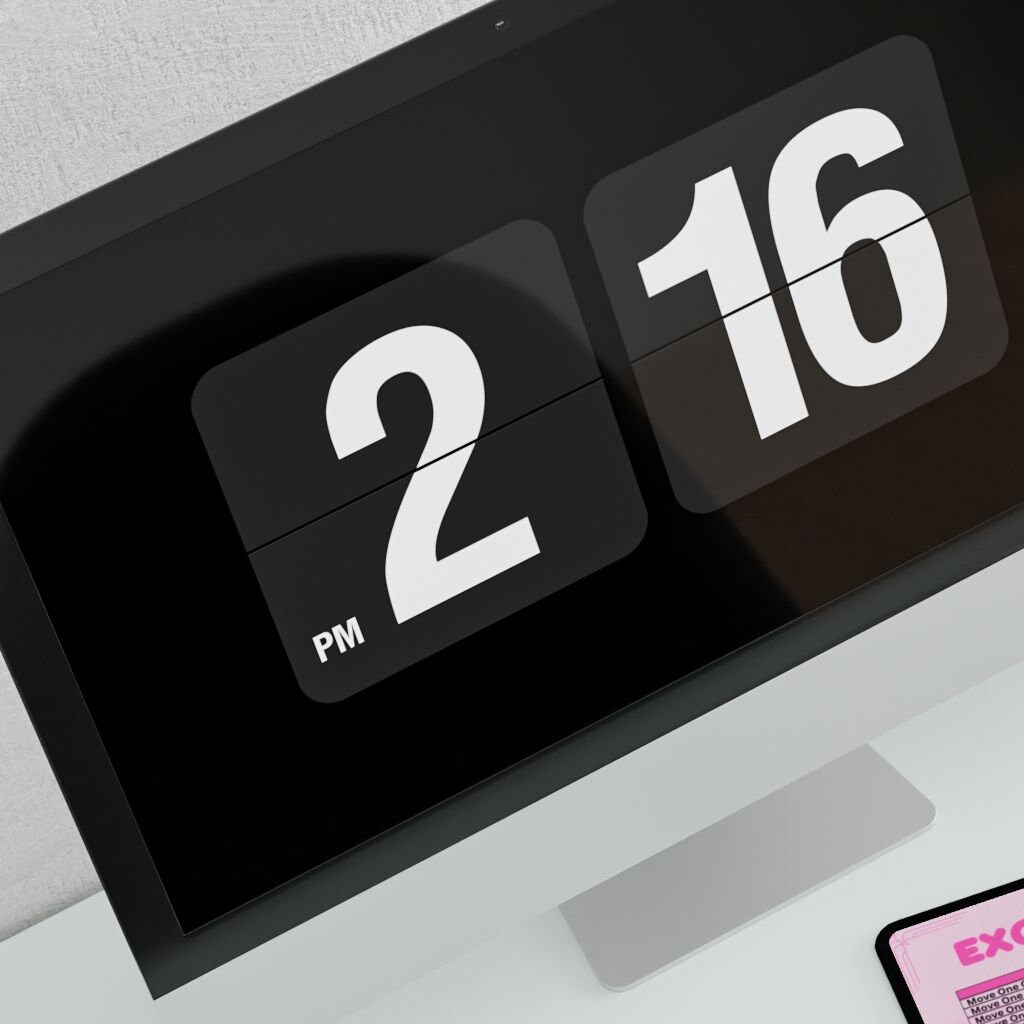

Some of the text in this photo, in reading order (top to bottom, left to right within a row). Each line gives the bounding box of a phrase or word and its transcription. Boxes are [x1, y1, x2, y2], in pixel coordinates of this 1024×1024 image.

[637, 108, 949, 440] 16
[325, 324, 541, 625] 2
[312, 616, 365, 664] PM
[965, 992, 996, 1007] Move
[996, 984, 1019, 996] One
